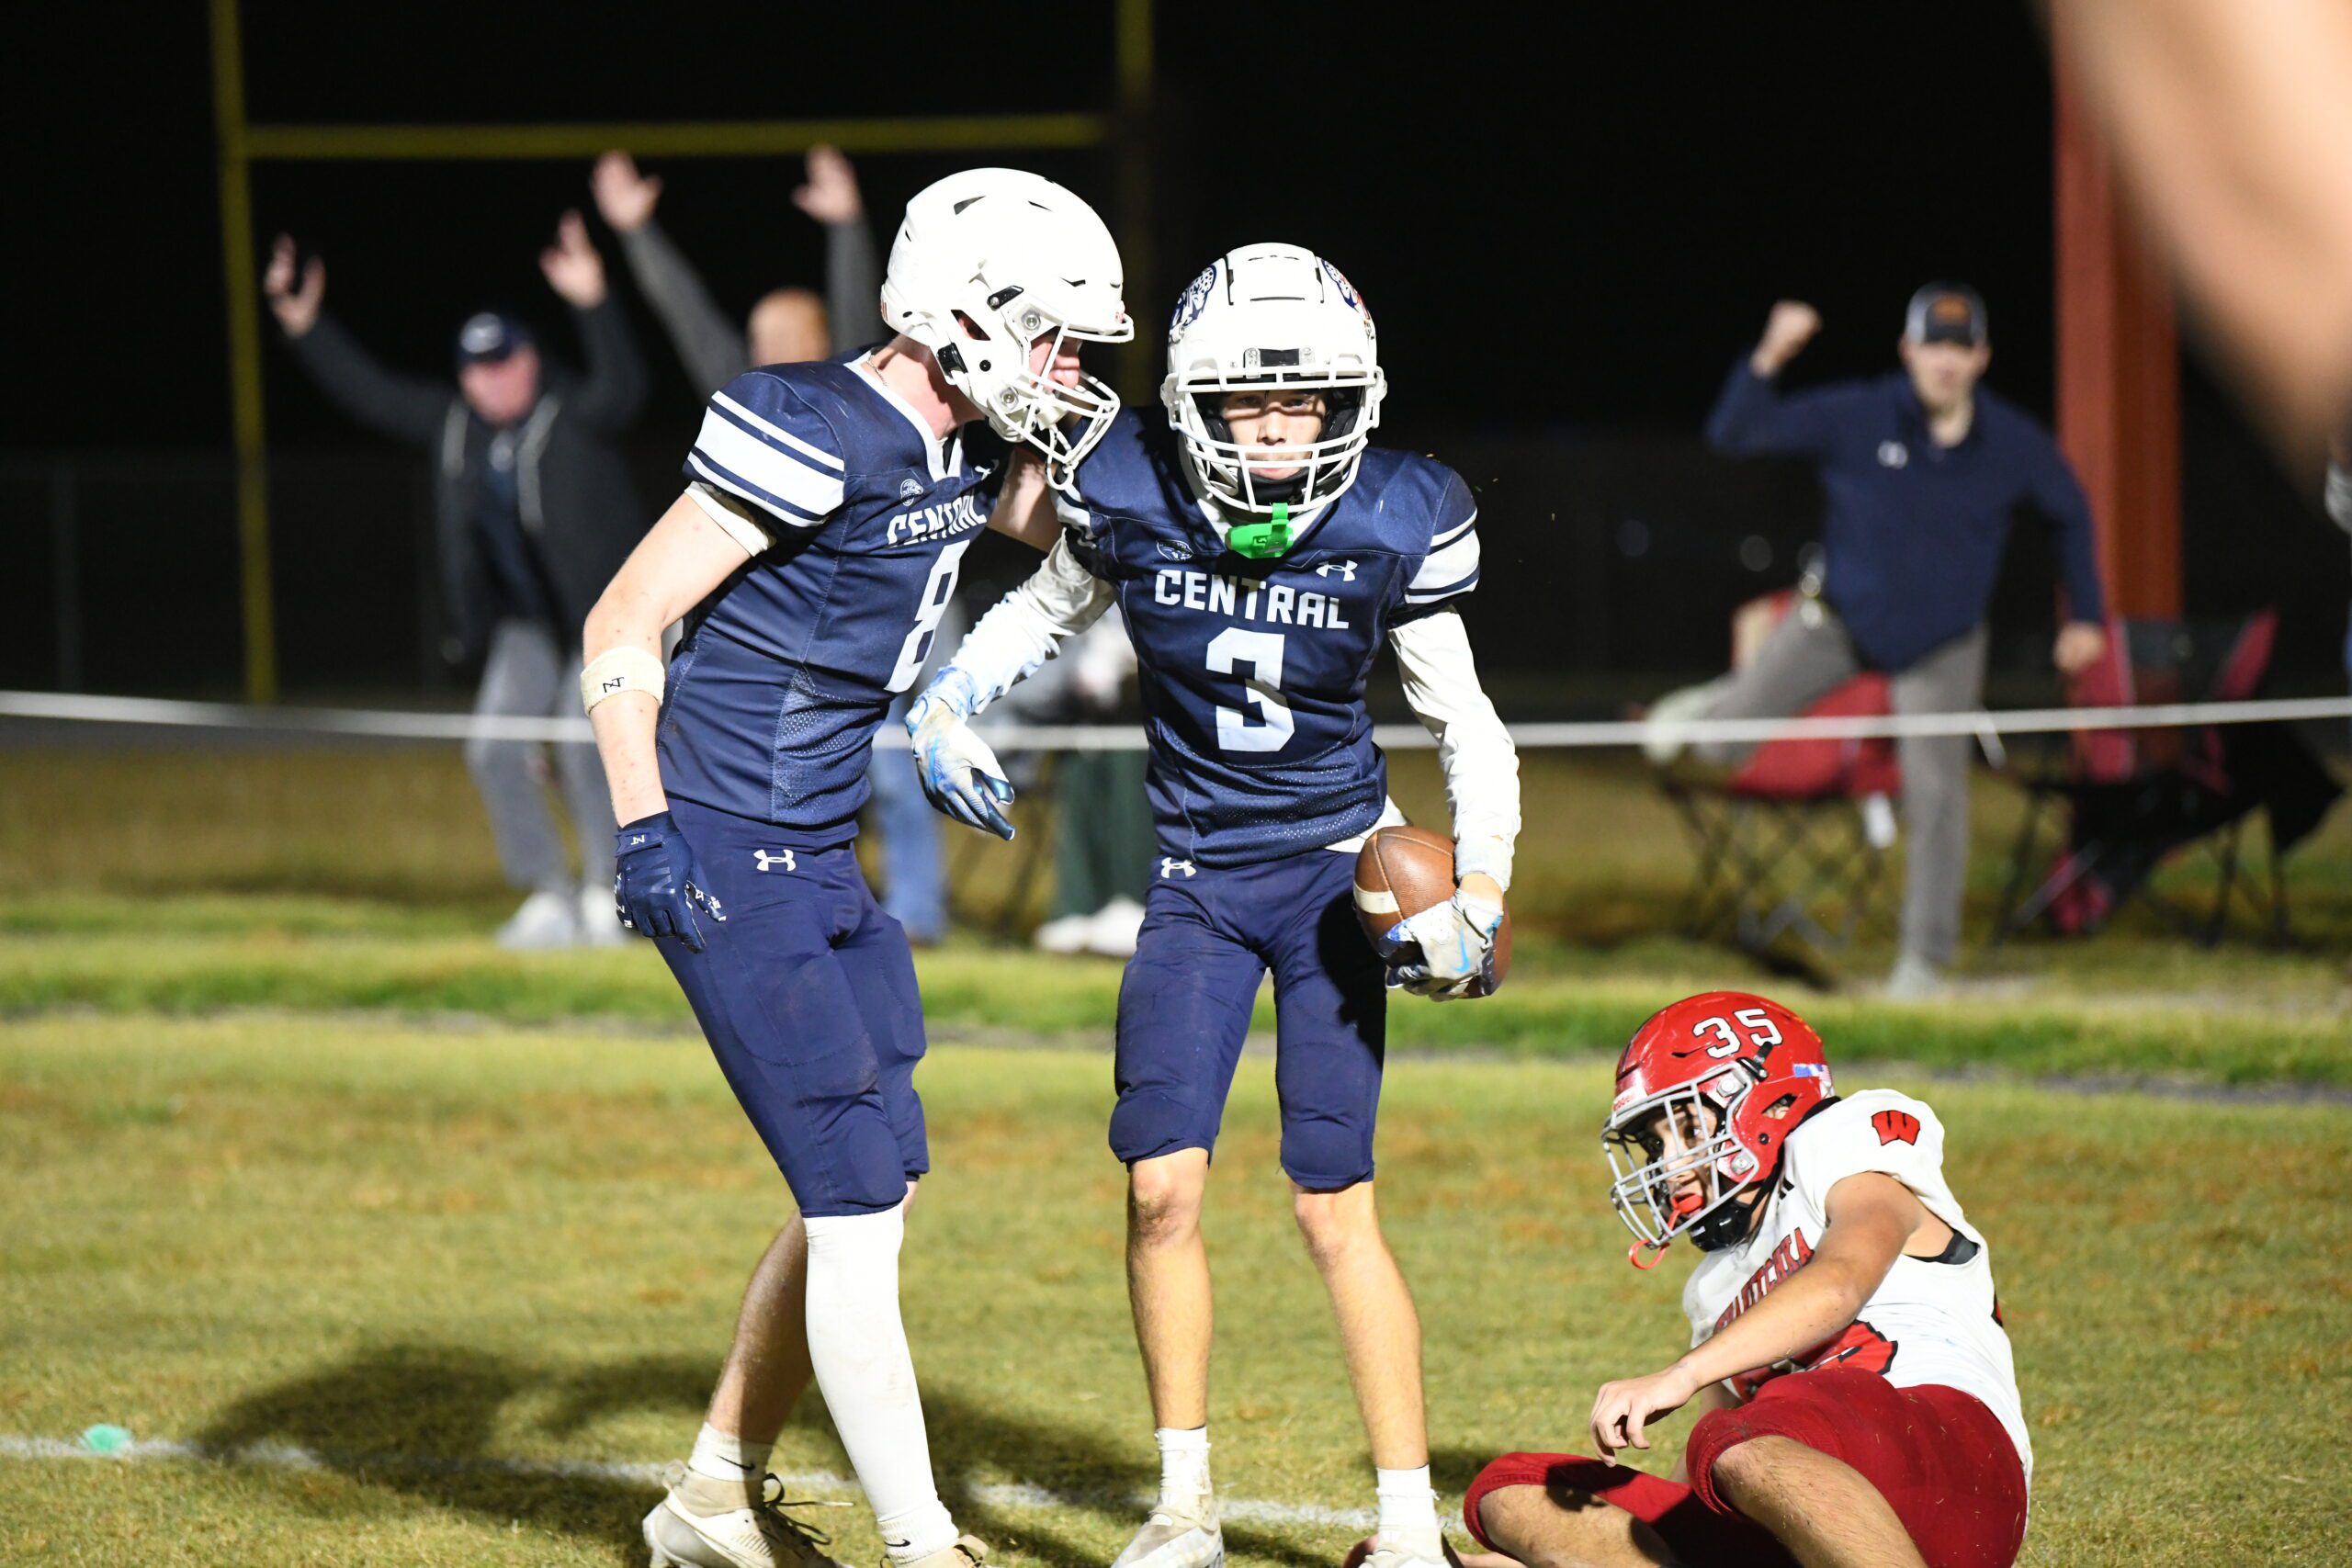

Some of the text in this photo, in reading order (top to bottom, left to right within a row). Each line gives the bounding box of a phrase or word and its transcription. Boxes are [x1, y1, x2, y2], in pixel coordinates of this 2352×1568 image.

[886, 495, 987, 548] CENTRAL
[883, 538, 970, 694] 8
[1154, 569, 1350, 629] CENTRAL
[1205, 626, 1295, 752] 3
[1692, 1008, 1783, 1060] 35
[1871, 1109, 1921, 1147] W
